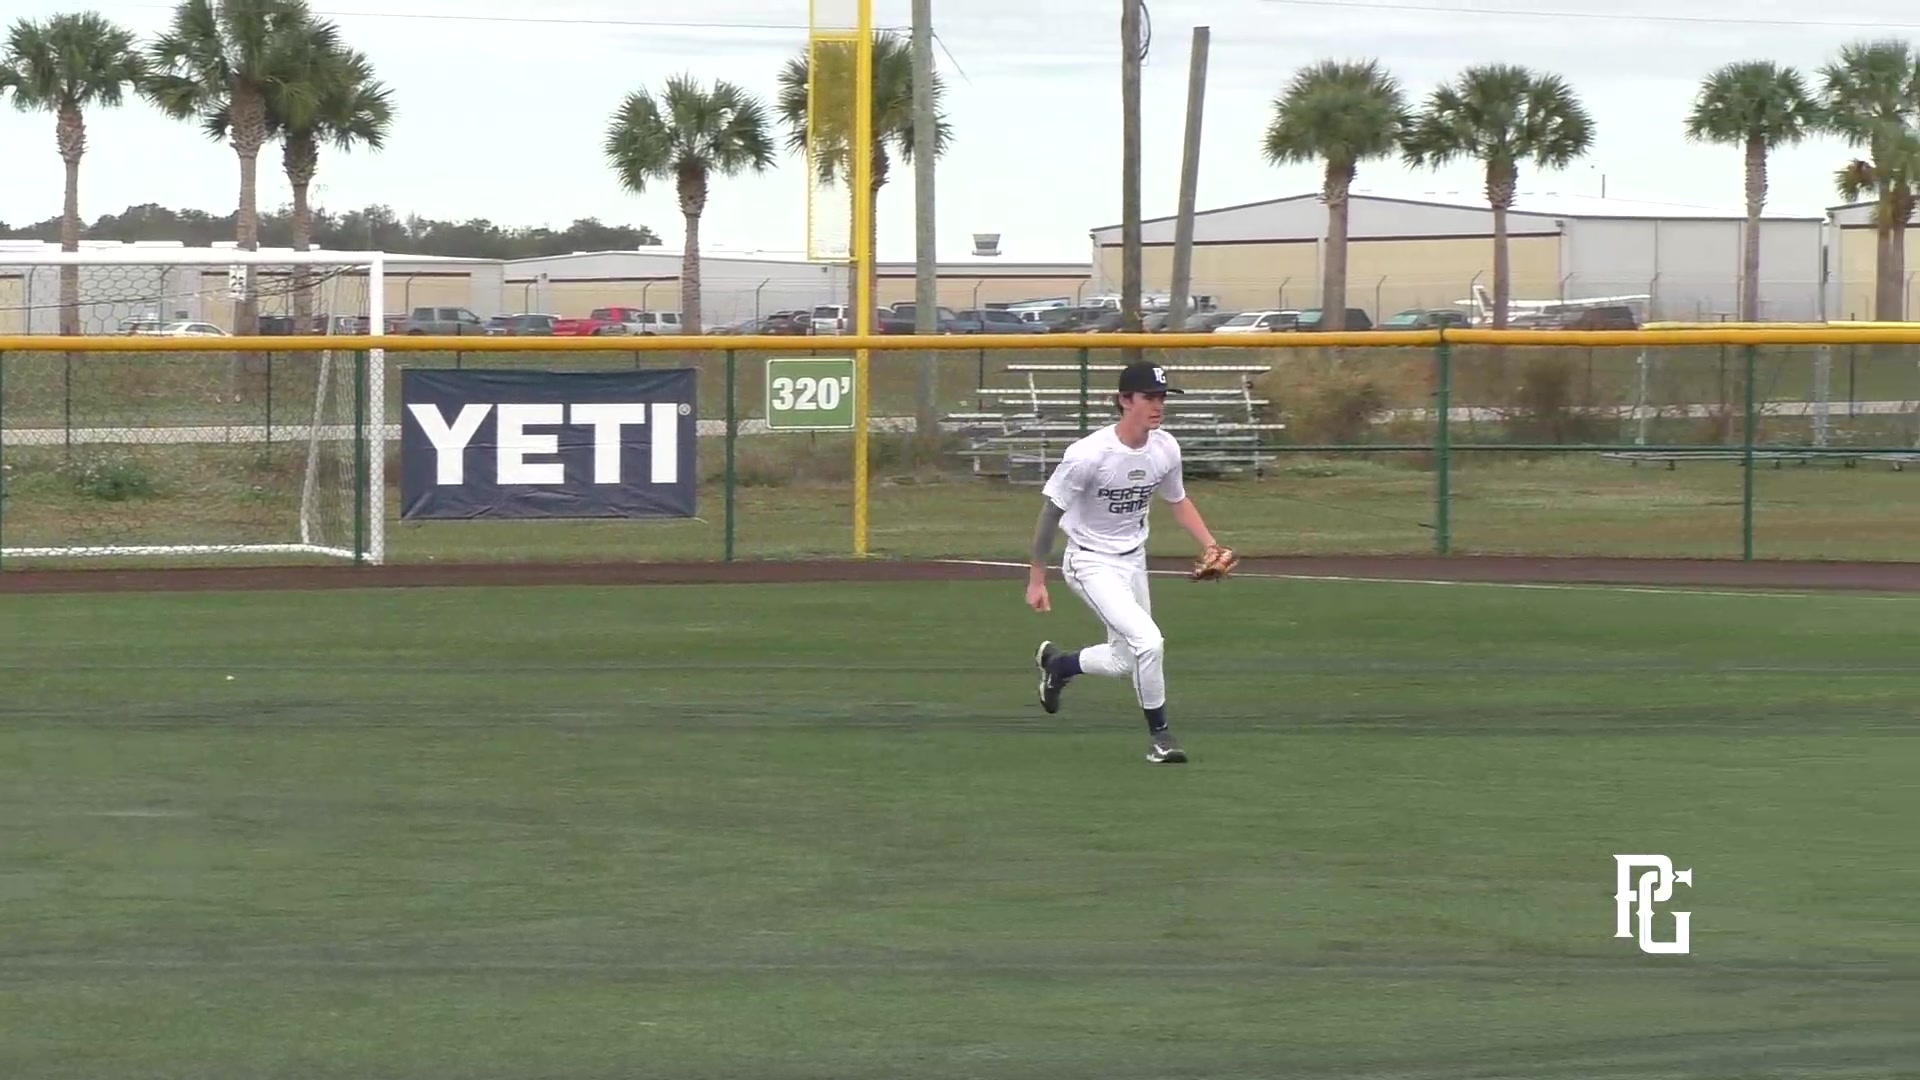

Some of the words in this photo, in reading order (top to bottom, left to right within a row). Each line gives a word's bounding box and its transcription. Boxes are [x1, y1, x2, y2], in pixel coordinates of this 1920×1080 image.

[771, 376, 851, 411] 320'
[406, 402, 679, 485] YETI
[1097, 482, 1159, 501] PERFE
